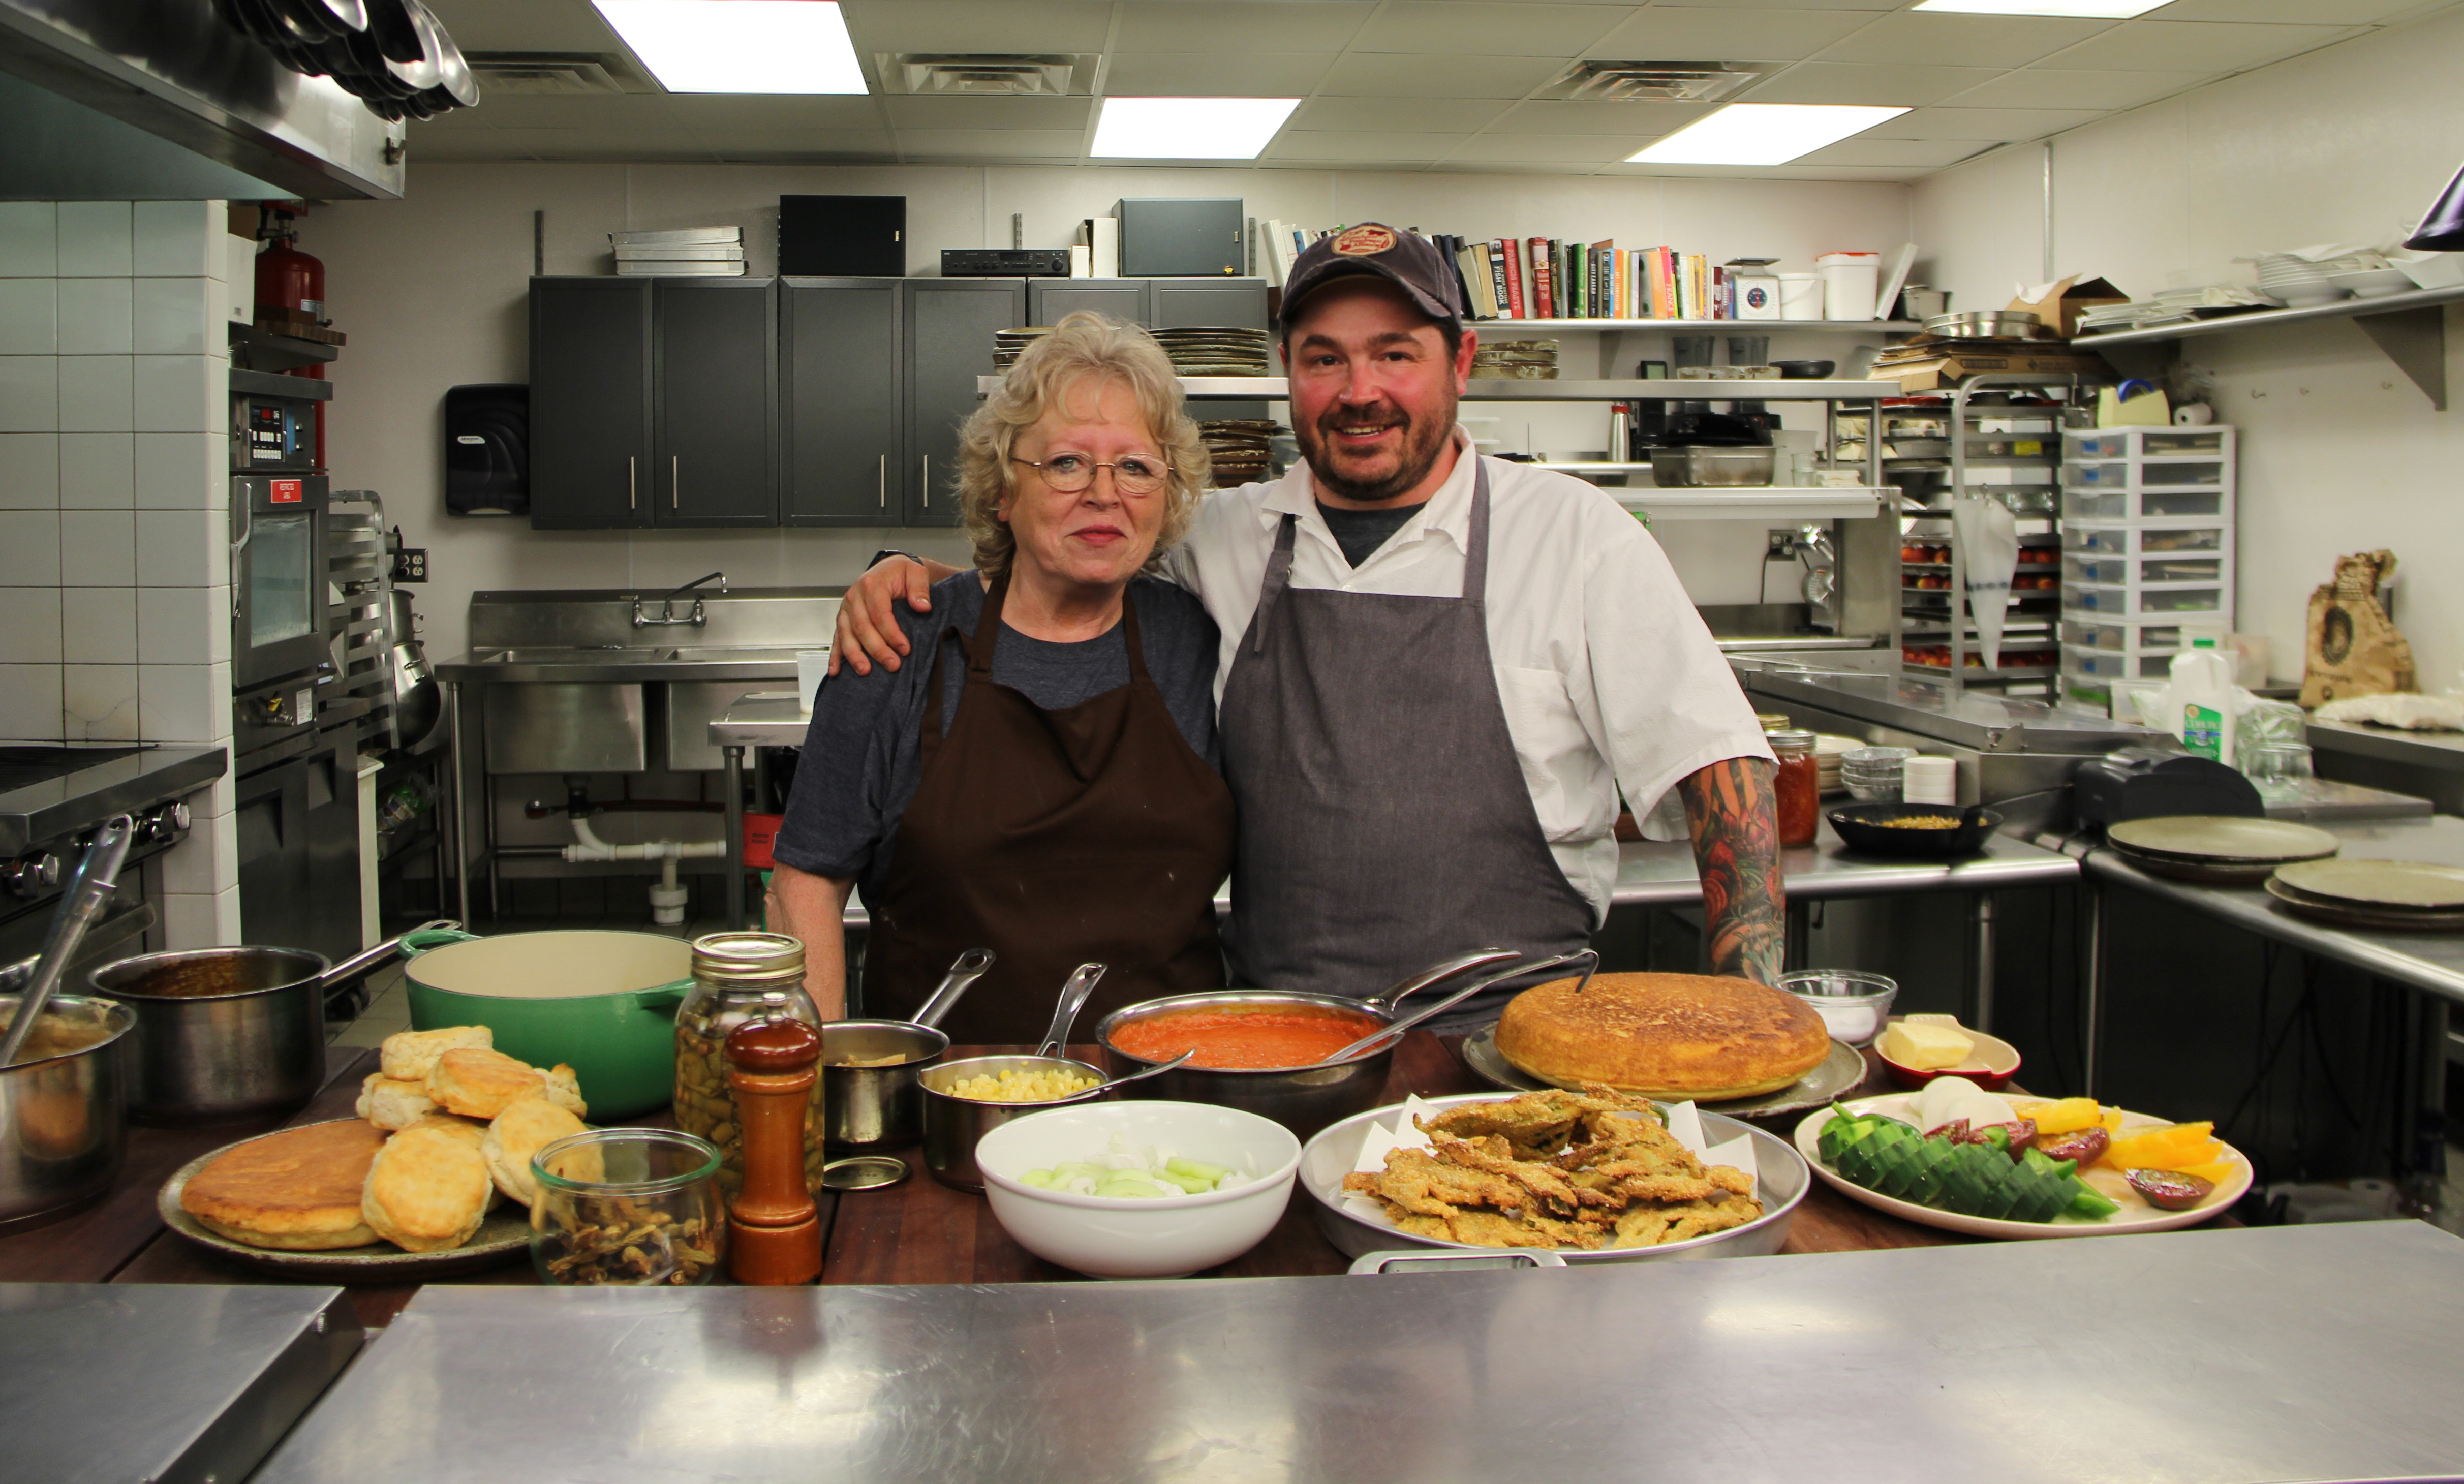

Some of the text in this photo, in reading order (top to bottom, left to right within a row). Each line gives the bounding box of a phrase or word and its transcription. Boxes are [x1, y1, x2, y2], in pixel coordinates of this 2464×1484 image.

[1508, 249, 1517, 280] FRENCH
[1497, 285, 1505, 305] BOOK
[1512, 282, 1521, 310] FEASTS
[1666, 284, 1674, 312] FRANCE
